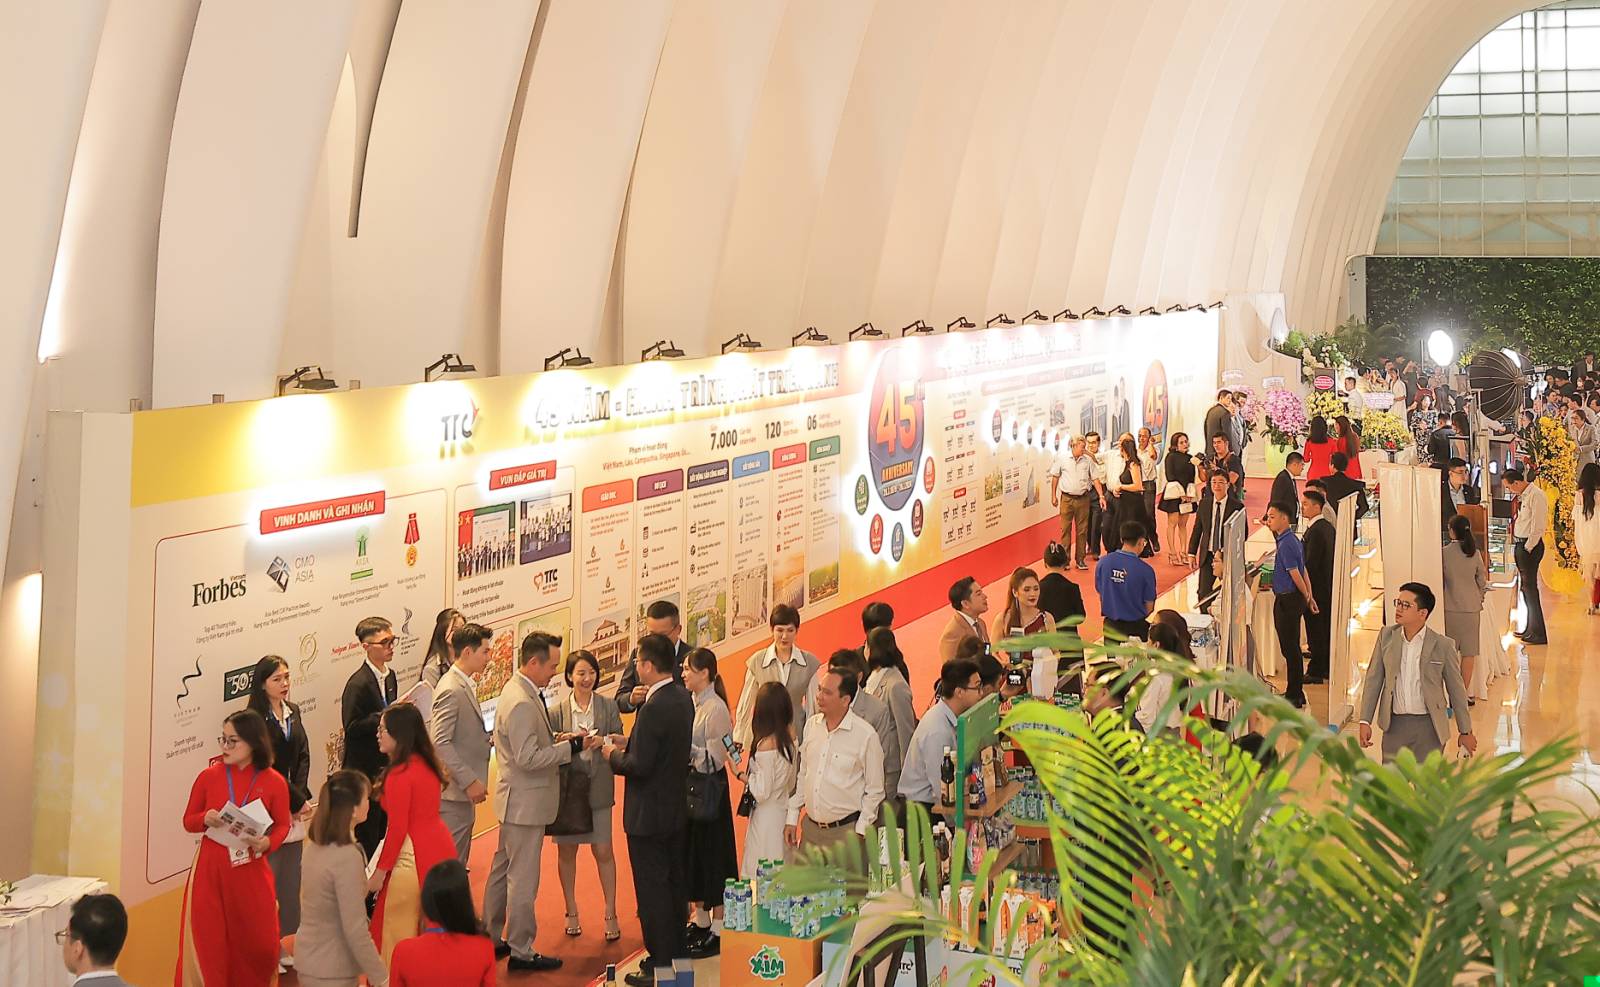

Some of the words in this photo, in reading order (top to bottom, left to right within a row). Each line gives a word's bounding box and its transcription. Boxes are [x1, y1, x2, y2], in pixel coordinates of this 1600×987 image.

[567, 386, 611, 425] ĂM
[441, 413, 473, 441] TTC
[808, 414, 816, 430] 06
[876, 379, 918, 456] 45
[710, 430, 738, 450] 7.000
[765, 421, 781, 440] 120
[274, 514, 296, 527] VINH
[297, 510, 322, 524] DANH
[322, 505, 334, 519] VÀ
[336, 504, 350, 516] GHI
[295, 554, 315, 569] CMO
[295, 569, 314, 583] ASIA
[544, 568, 558, 584] TTC
[1112, 569, 1125, 578] TTC
[192, 578, 247, 607] Forbes
[230, 672, 249, 694] 50
